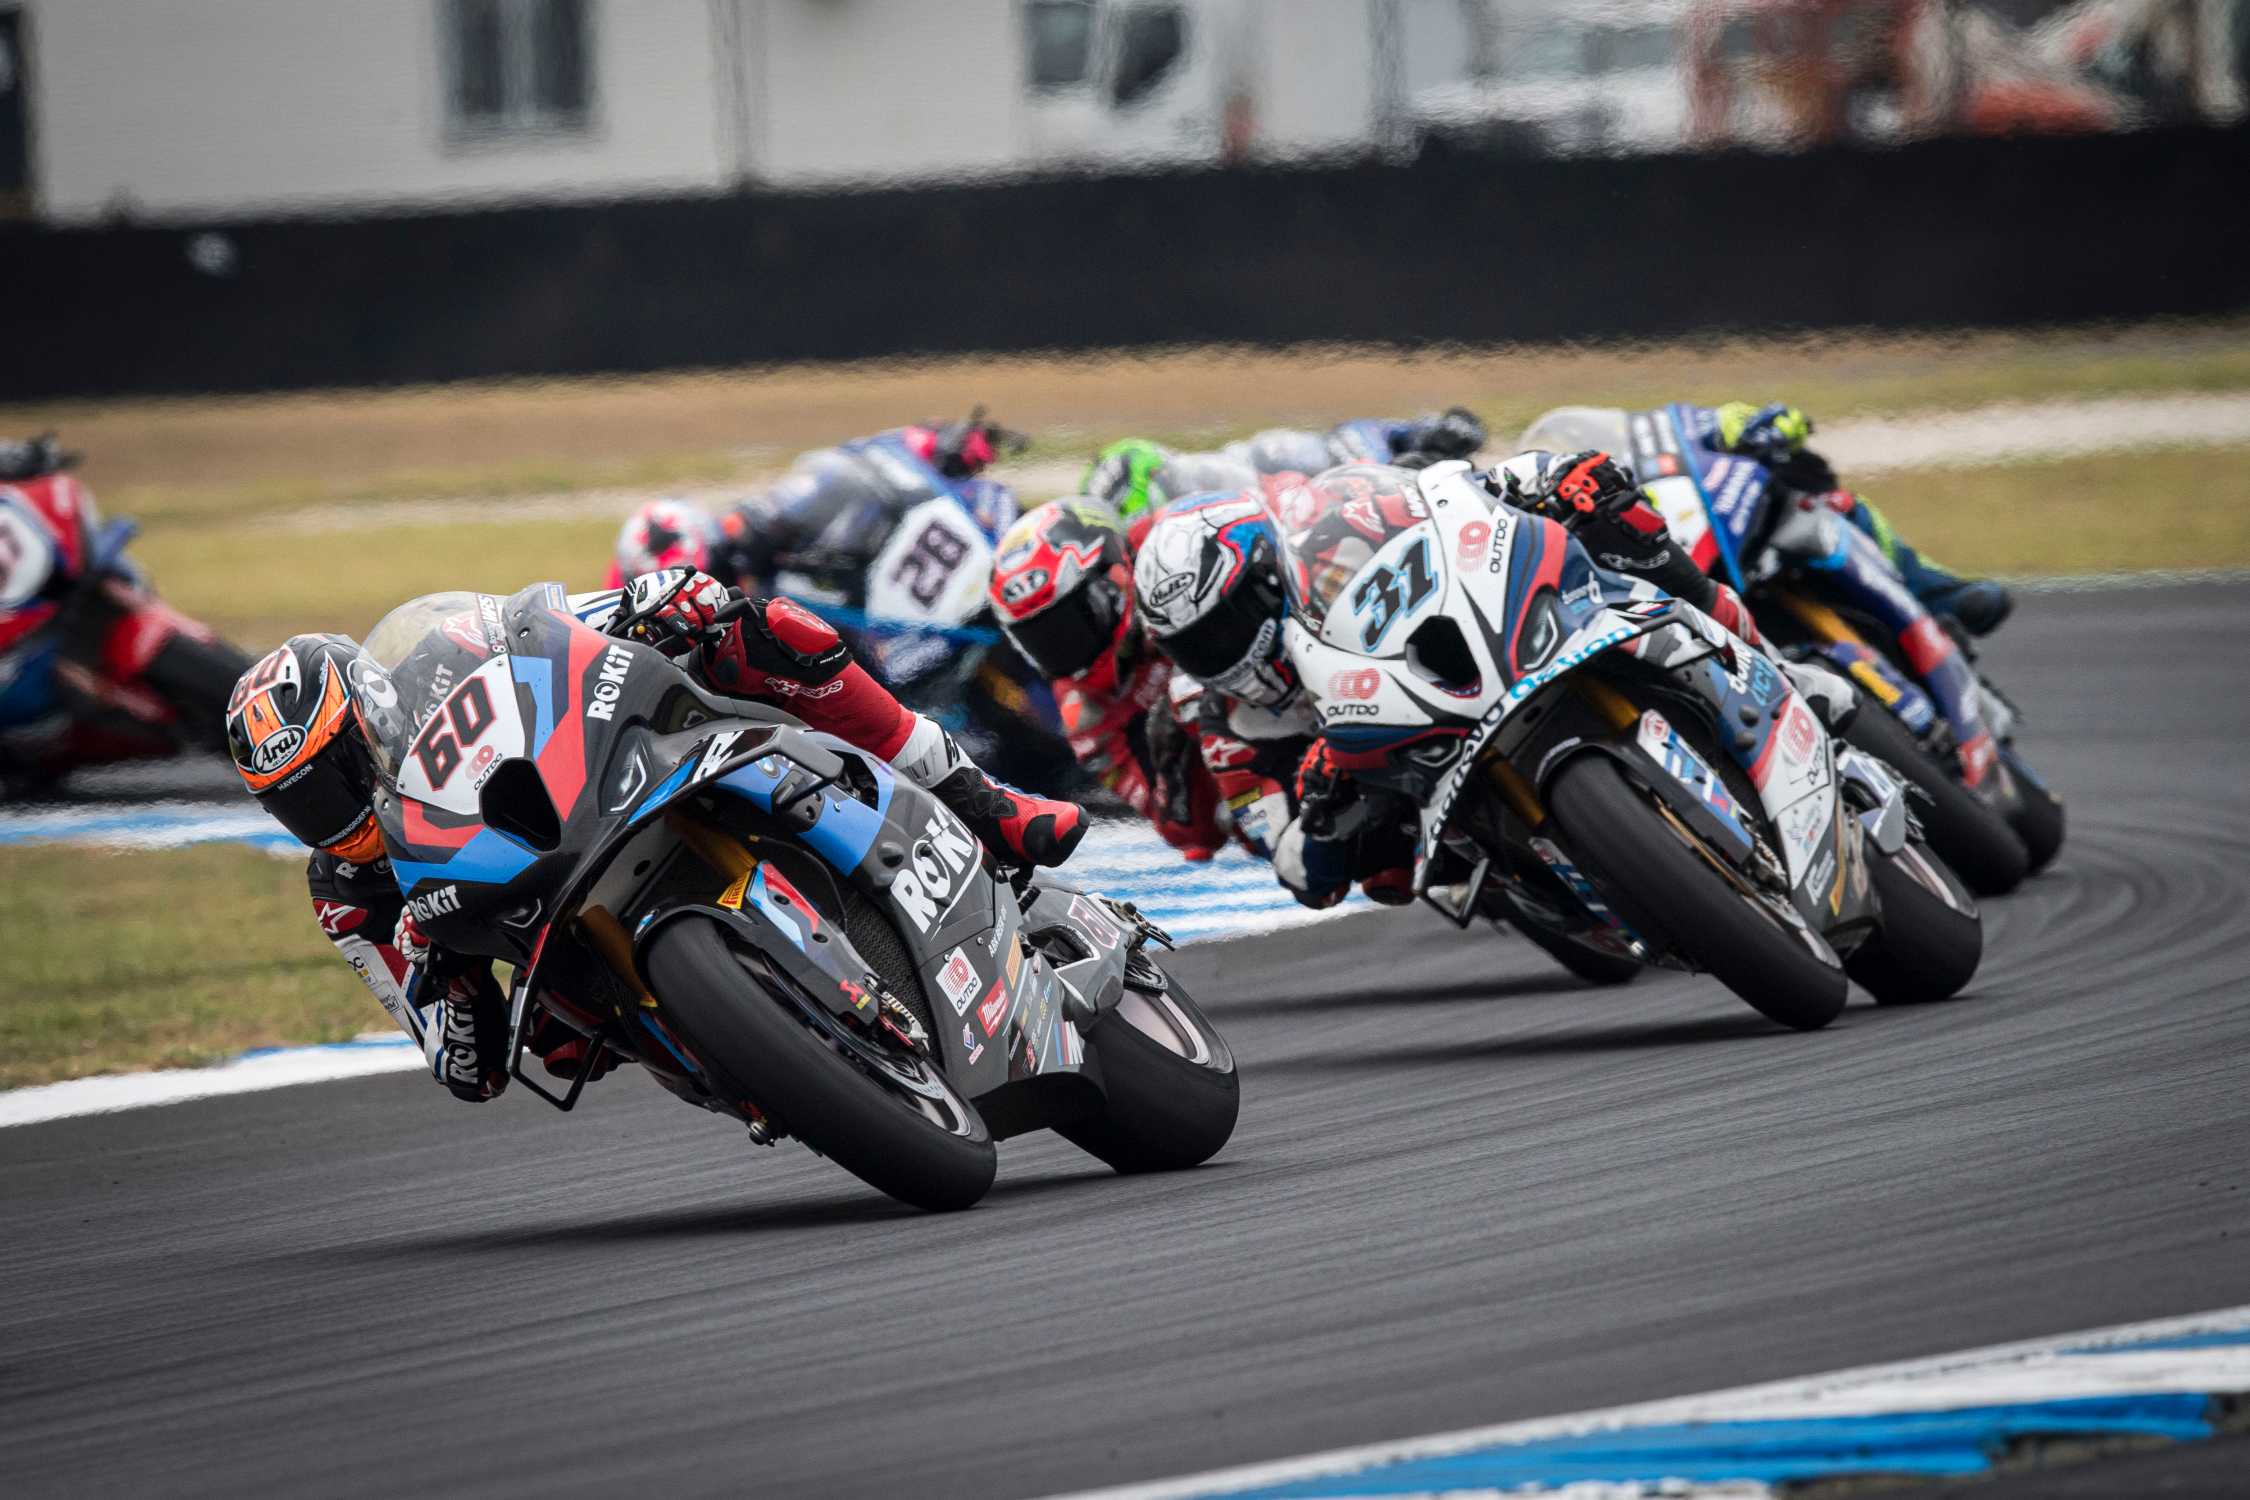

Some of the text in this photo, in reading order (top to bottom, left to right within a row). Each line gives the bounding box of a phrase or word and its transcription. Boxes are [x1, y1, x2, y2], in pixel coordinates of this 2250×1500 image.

[892, 519, 971, 609] 28
[1490, 518, 1508, 574] OUTDO
[1354, 536, 1438, 653] 31
[1327, 704, 1380, 717] OUTDO
[259, 730, 298, 770] Arai
[409, 675, 497, 792] 60
[277, 763, 313, 791] HAVECON
[474, 753, 503, 791] OUTDO
[956, 977, 979, 1010] OUTDO
